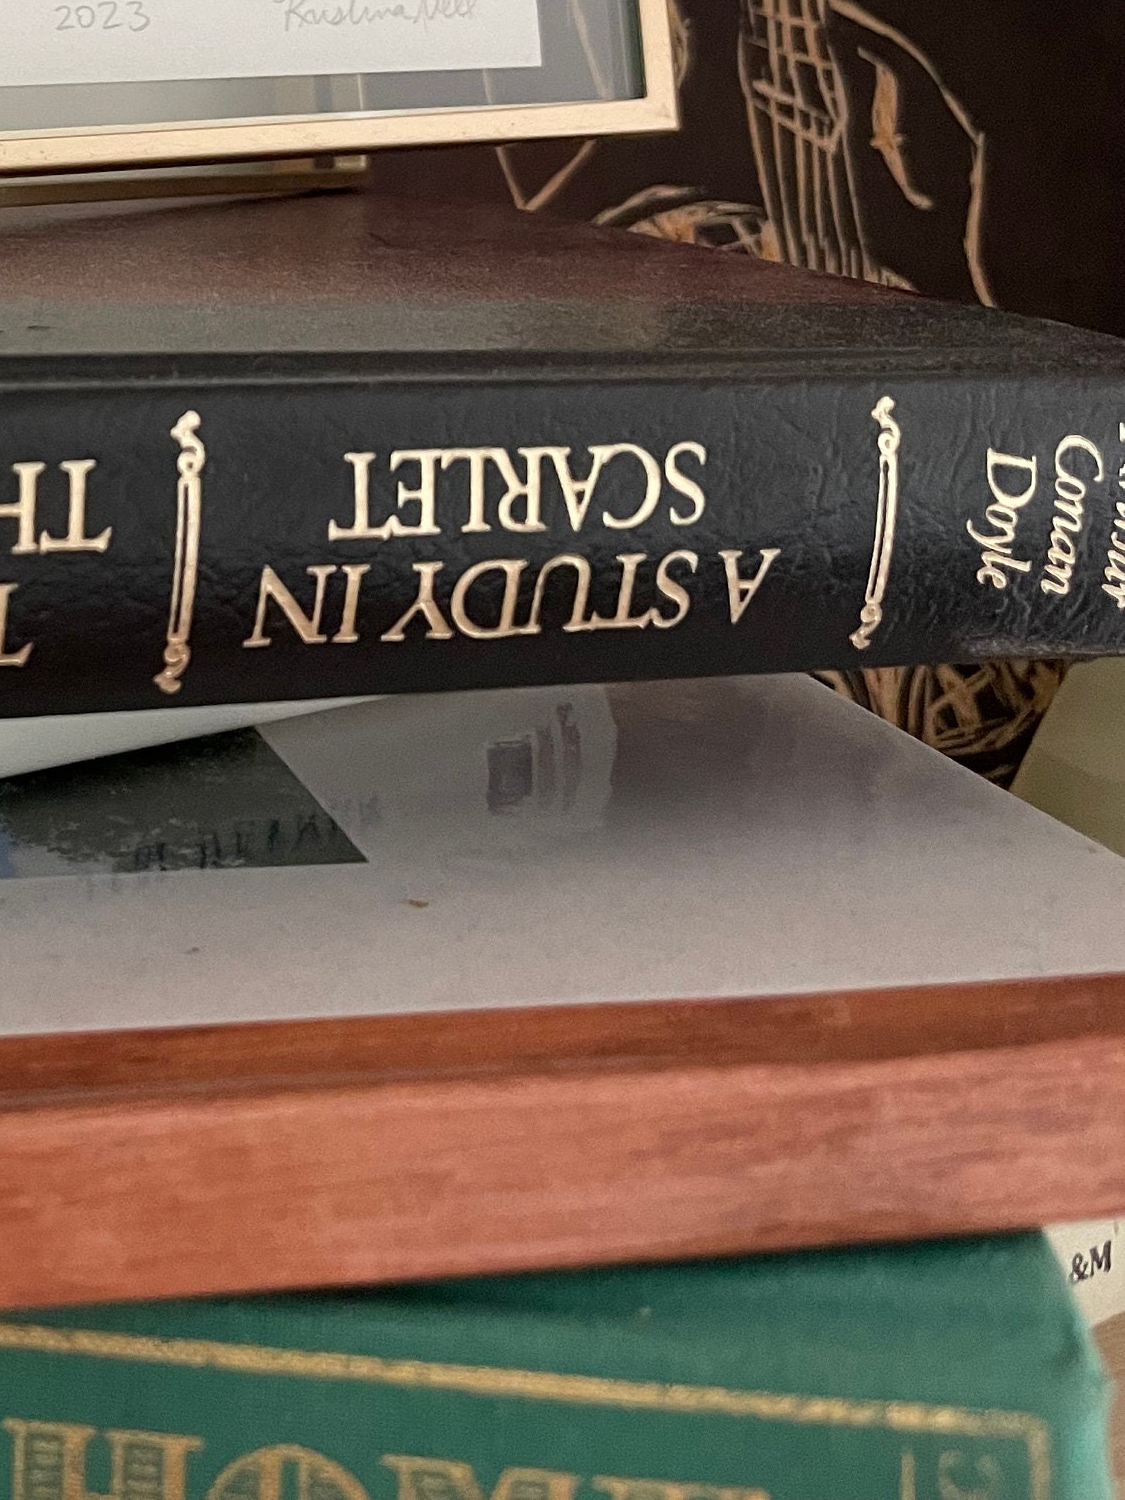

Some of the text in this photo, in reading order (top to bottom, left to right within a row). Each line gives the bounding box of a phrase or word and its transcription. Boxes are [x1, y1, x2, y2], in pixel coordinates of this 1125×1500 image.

[54, 0, 151, 32] 2023
[328, 441, 707, 542] SCARLET
[966, 447, 1037, 589] Doyle
[1040, 434, 1104, 596] Conan
[242, 548, 781, 648] A STUDY IN
